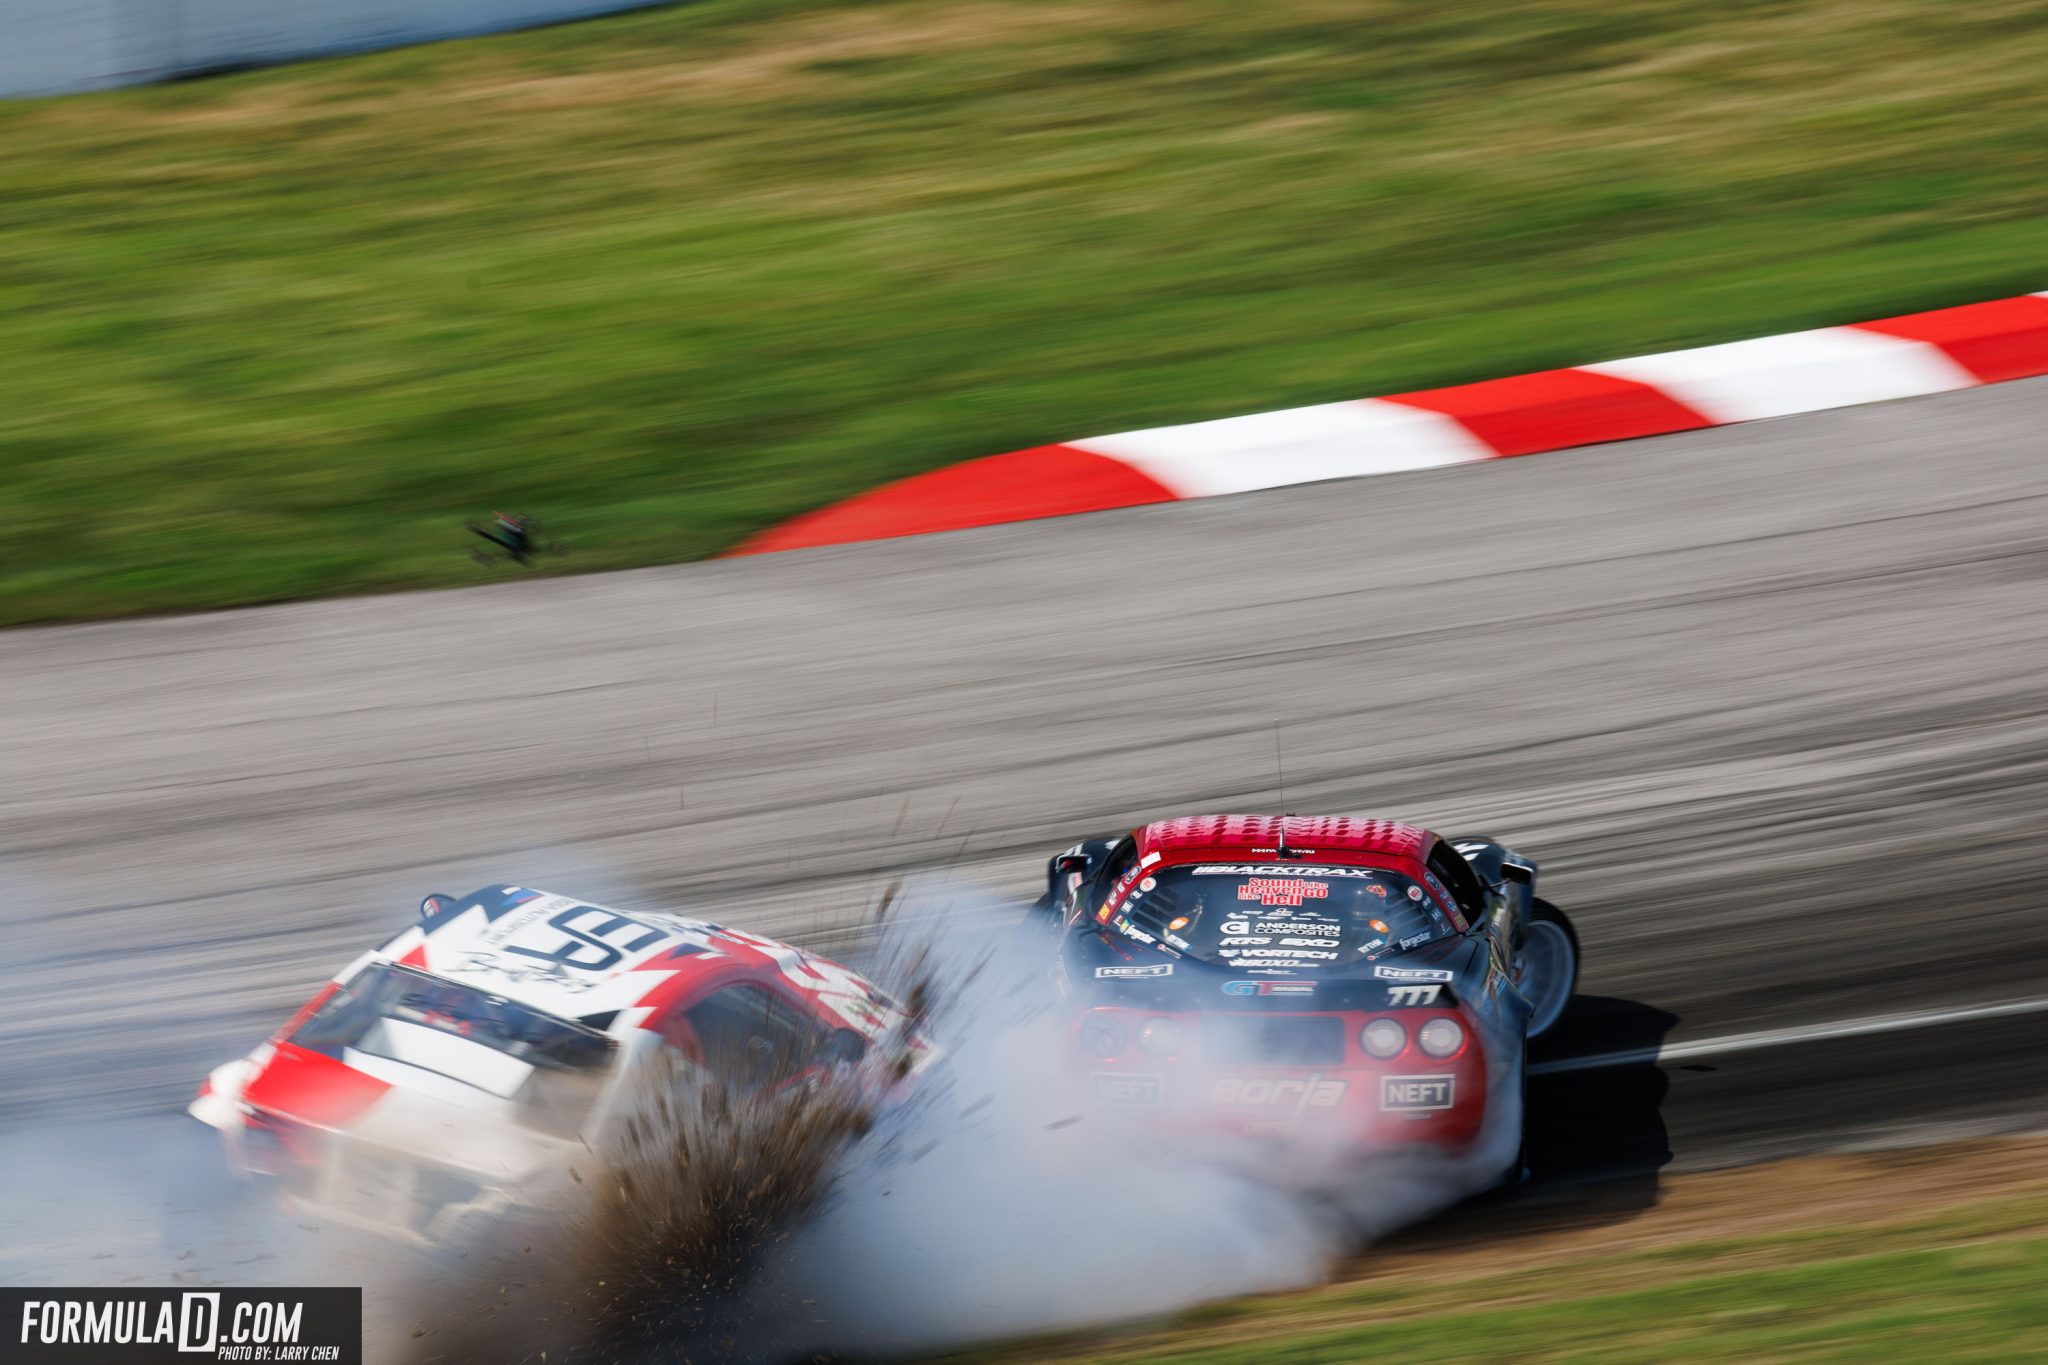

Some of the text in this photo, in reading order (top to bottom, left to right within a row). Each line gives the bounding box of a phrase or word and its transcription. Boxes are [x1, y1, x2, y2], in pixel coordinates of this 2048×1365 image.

[1249, 878, 1303, 887] Sound
[1239, 885, 1303, 894] Heaven
[1262, 895, 1302, 905] Hell
[1254, 922, 1341, 931] ANDERSON
[1254, 928, 1340, 937] COMPOSITES
[1219, 937, 1273, 946] RTS
[1241, 949, 1339, 960] VORTECH
[1103, 967, 1165, 976] NEFT
[1381, 968, 1446, 978] NEFT
[1388, 1082, 1448, 1103] NEFT
